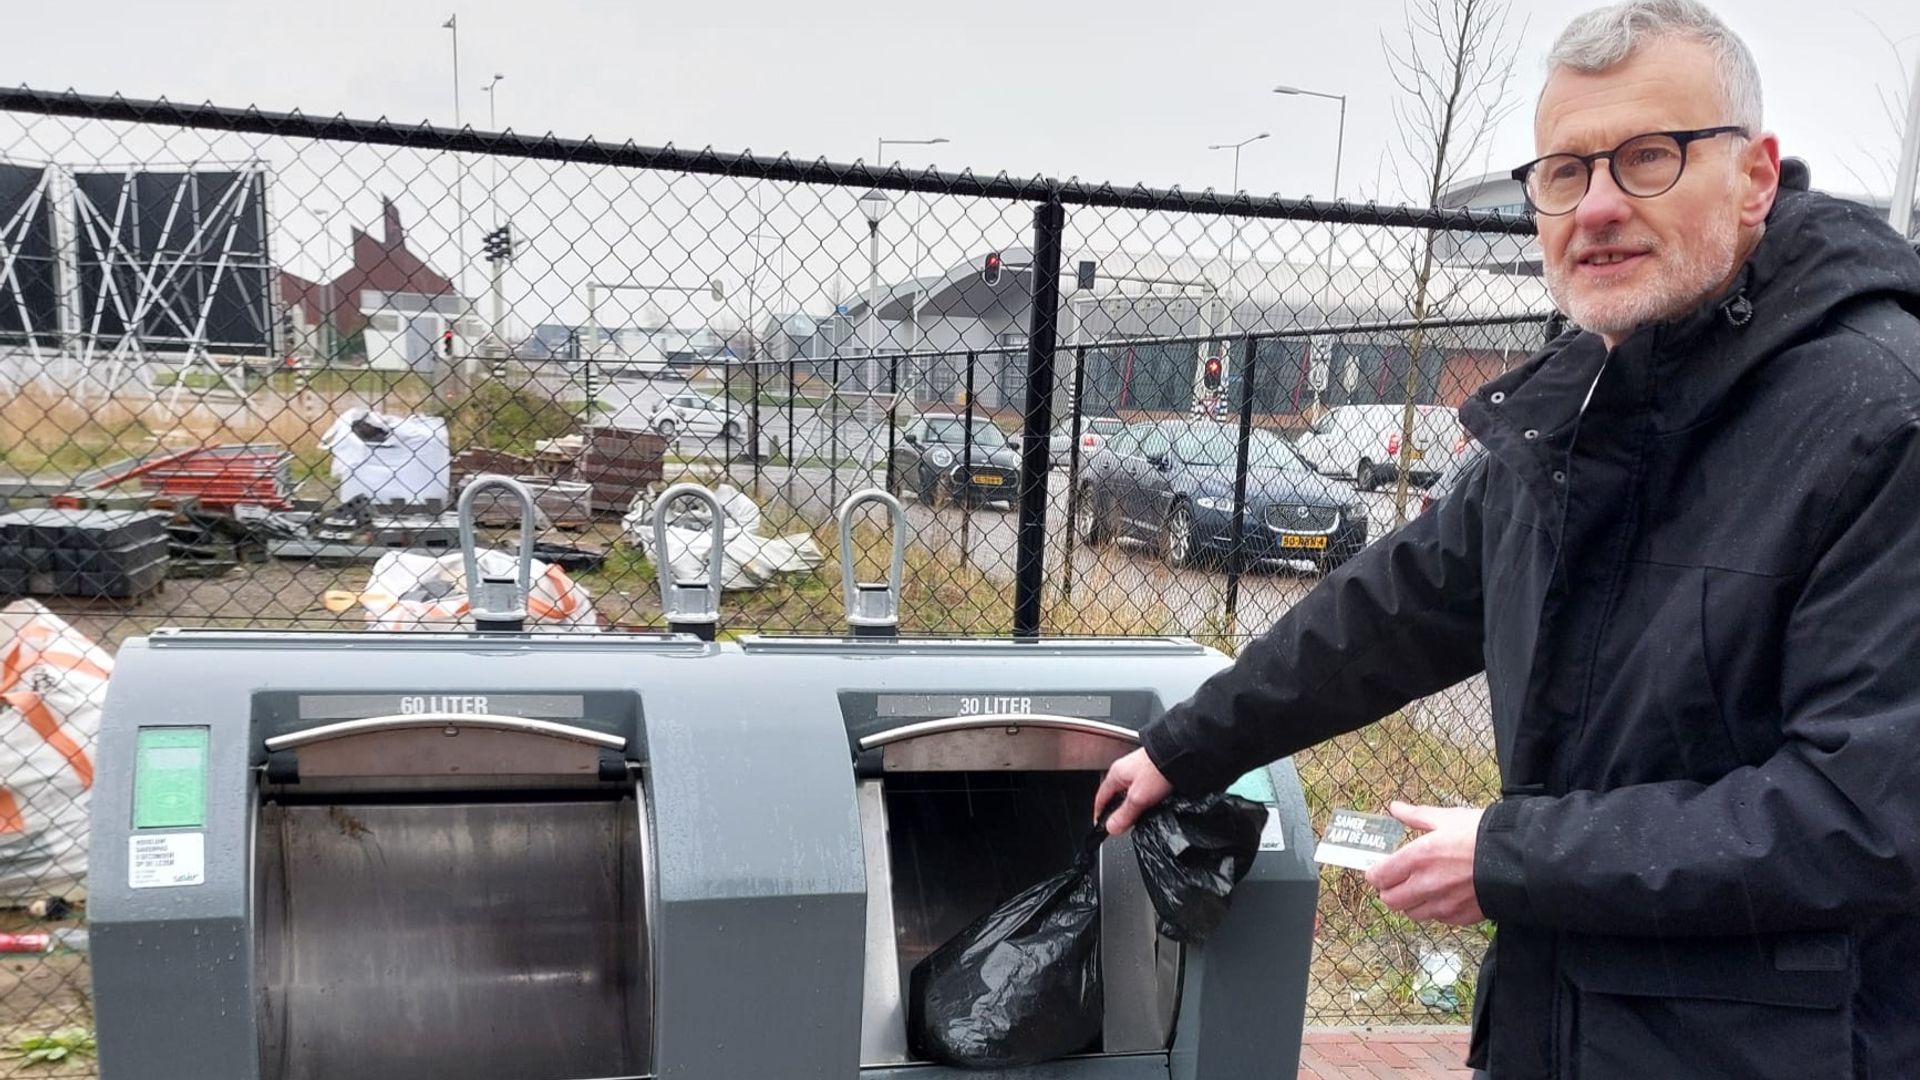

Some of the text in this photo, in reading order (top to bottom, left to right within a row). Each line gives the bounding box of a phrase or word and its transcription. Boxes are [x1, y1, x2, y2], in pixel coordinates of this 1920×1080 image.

[400, 696, 489, 714] 60 LITER
[960, 696, 1031, 714] 30 LITER
[1347, 830, 1362, 844] DE
